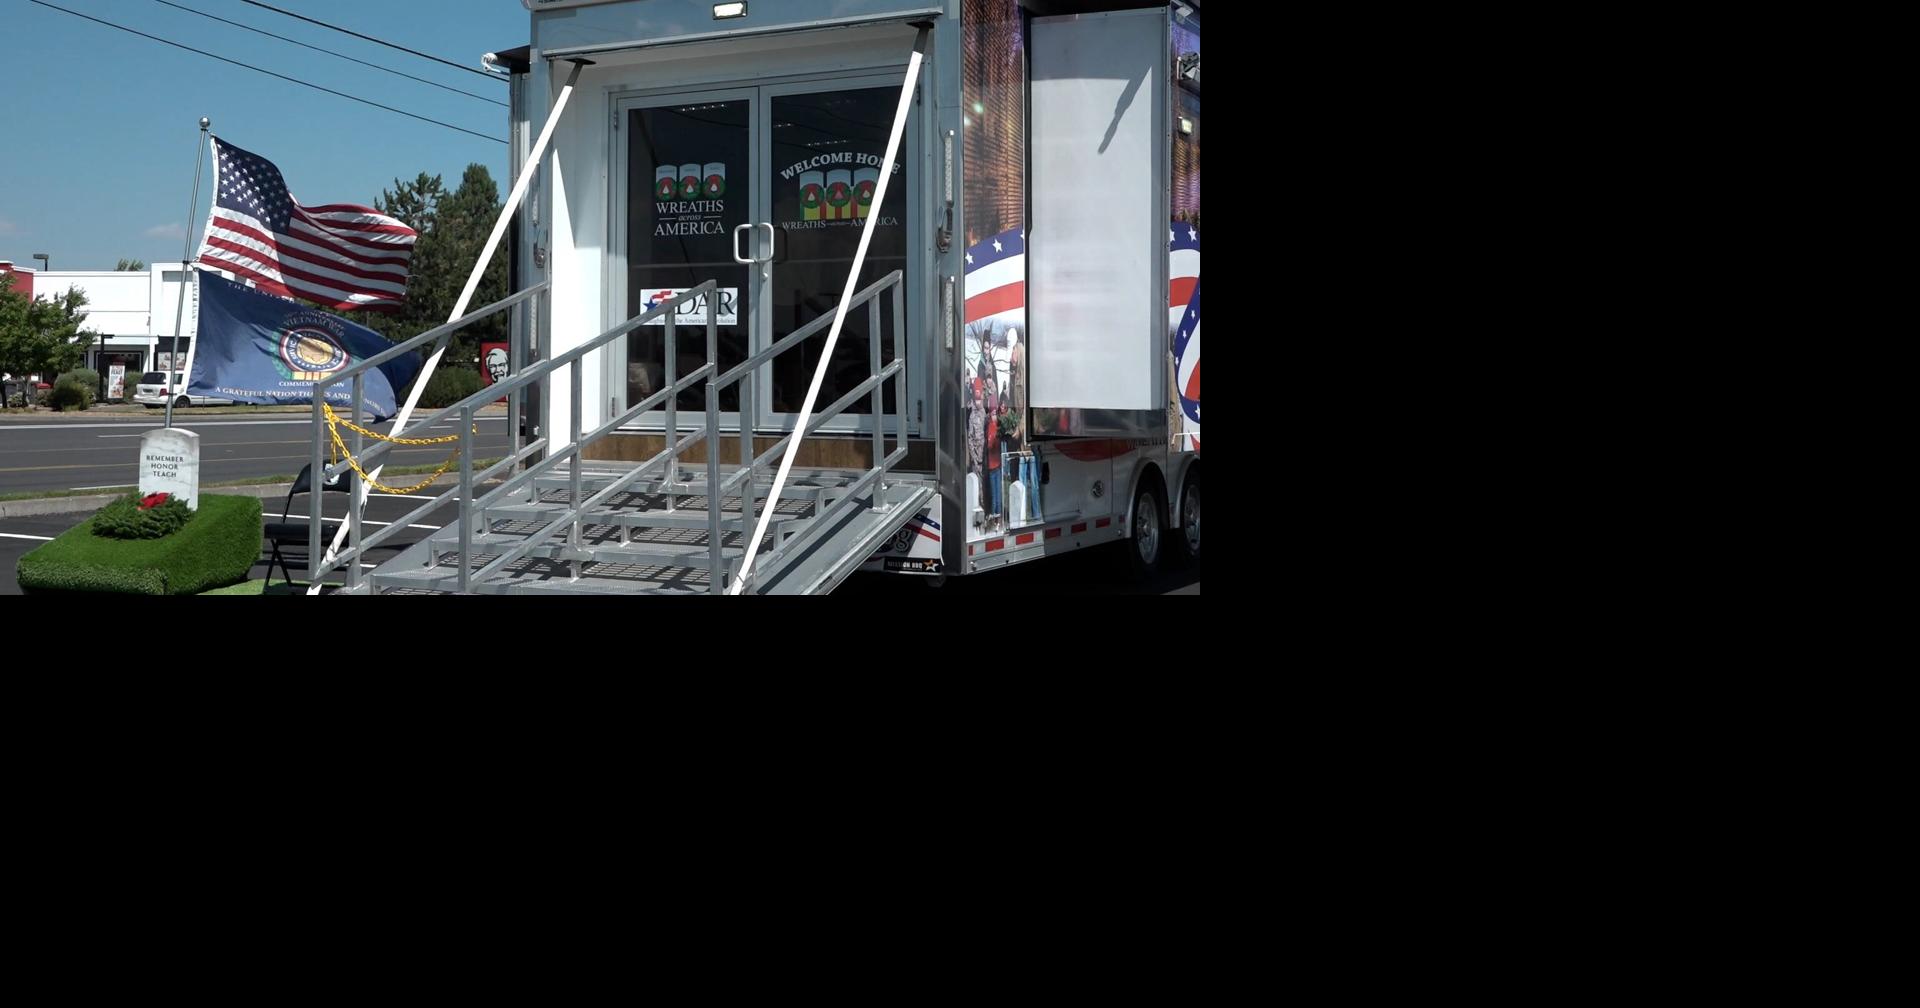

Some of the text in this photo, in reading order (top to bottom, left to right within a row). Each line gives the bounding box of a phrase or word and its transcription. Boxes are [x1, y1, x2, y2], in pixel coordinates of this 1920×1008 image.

[781, 152, 853, 180] WELCOME
[656, 200, 724, 214] WREATHS
[654, 221, 725, 236] AMERICA
[782, 220, 827, 230] WREATHS
[850, 216, 898, 227] AMRICA
[222, 387, 265, 397] GRATEFUL
[299, 390, 331, 398] THAS
[331, 392, 351, 400] AND
